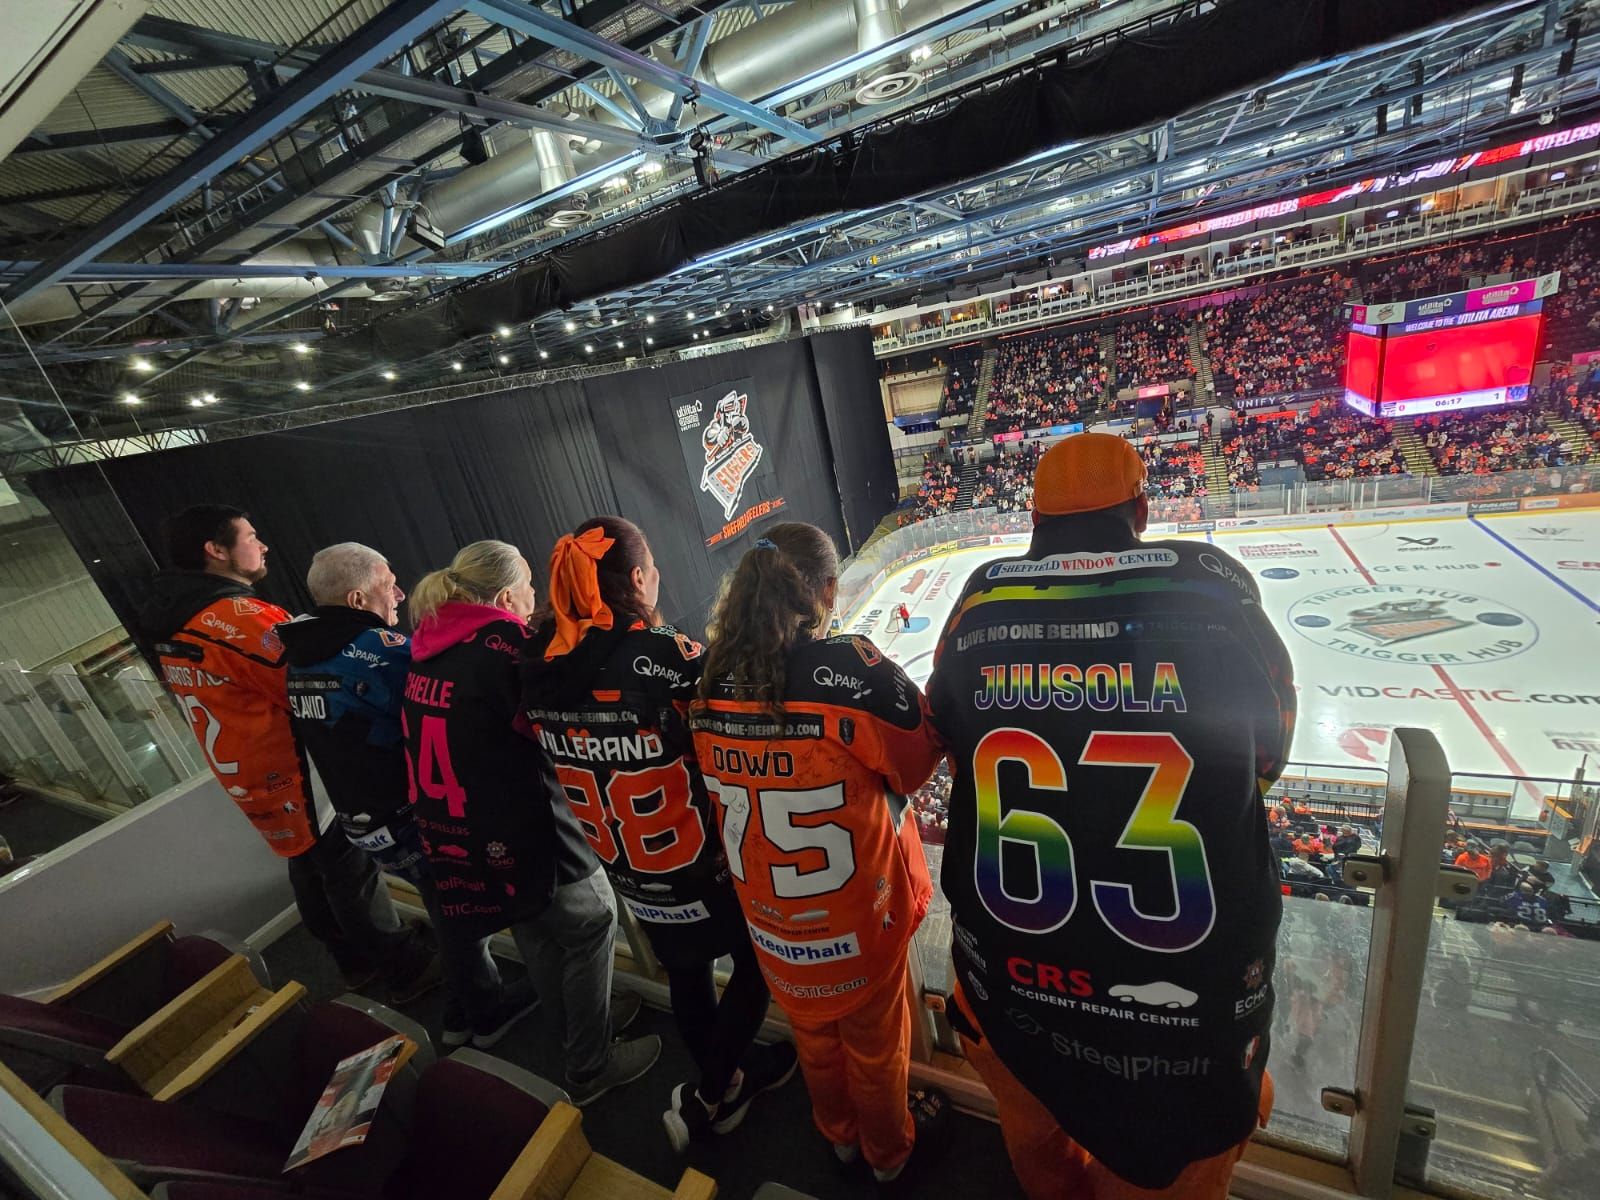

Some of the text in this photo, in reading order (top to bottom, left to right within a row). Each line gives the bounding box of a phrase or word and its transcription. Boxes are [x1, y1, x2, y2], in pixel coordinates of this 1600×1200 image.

[1457, 310, 1489, 325] UTILITA
[1489, 304, 1520, 319] ARENA
[1237, 397, 1276, 409] UNIFY
[1435, 398, 1462, 407] 06:17
[1001, 552, 1173, 574] SHEFFIELD WINDOW CENTRE
[1435, 563, 1480, 571] HUB
[1303, 586, 1479, 606] TRIGGER HUB
[957, 621, 1120, 652] LEAVE NO ONE BEHIND
[1327, 638, 1524, 662] TRIGGER HUB
[633, 655, 683, 684] QPARK
[975, 662, 1188, 713] JUUSOLA
[712, 745, 794, 777] DOWD
[703, 780, 857, 899] 75
[973, 727, 1217, 954] 63
[1517, 905, 1547, 922] 28
[750, 927, 852, 961] SteelPhalt
[1006, 957, 1094, 998] CRS
[1010, 985, 1076, 1009] ACCIDENT
[1081, 1002, 1135, 1021] REPAIR
[1139, 1012, 1200, 1027] CENTRE
[1235, 983, 1268, 1014] ECHO
[1051, 1031, 1211, 1081] SteelPhalt
